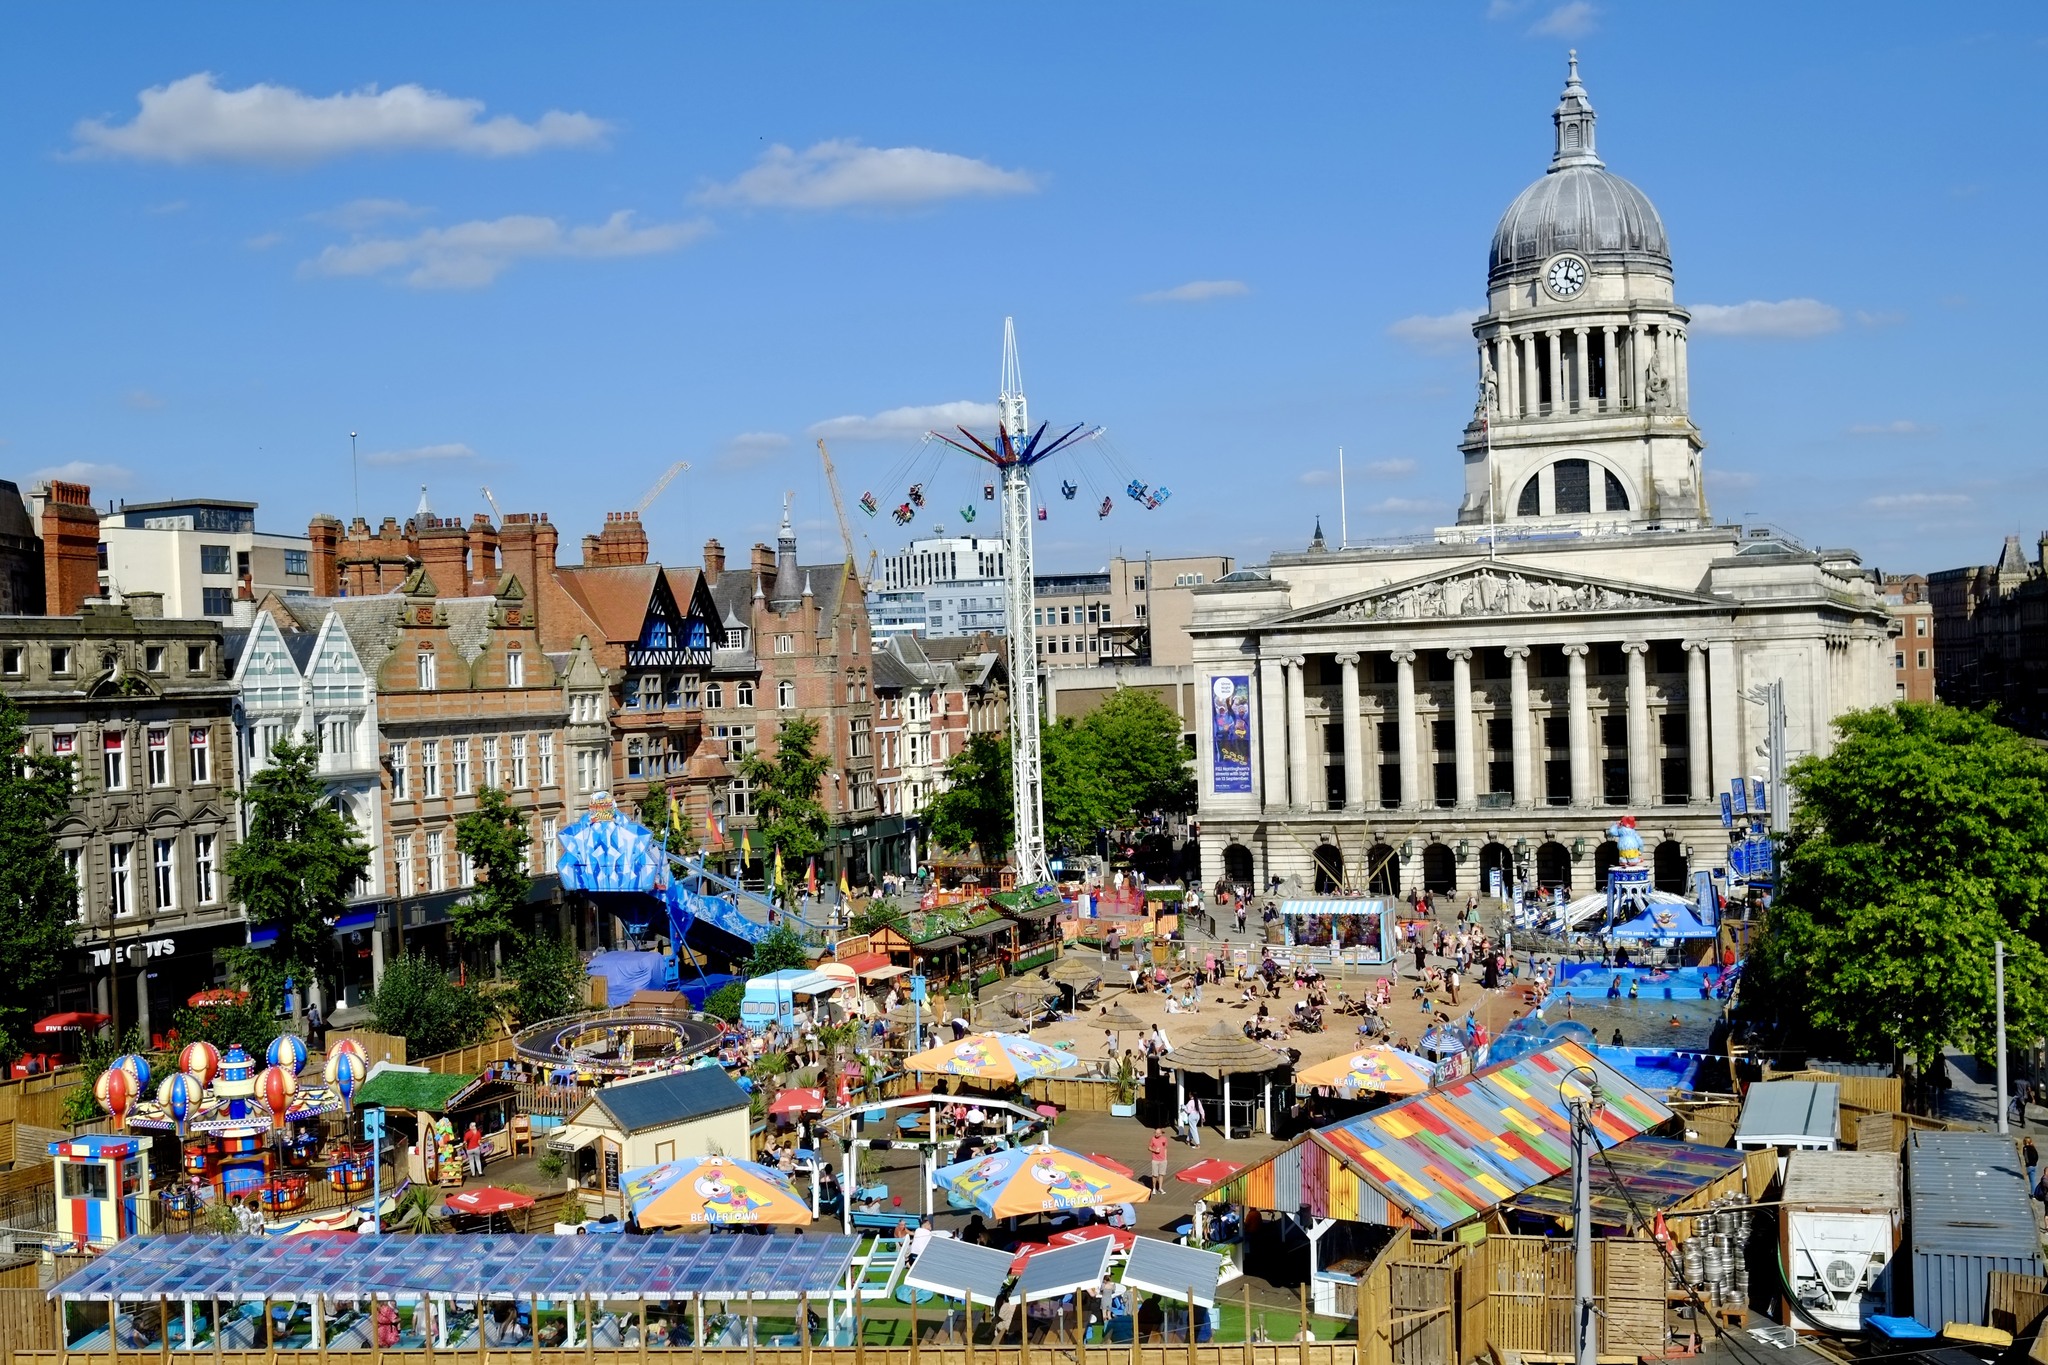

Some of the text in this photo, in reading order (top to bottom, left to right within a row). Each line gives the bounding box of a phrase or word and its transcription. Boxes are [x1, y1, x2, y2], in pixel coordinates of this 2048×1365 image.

[1492, 870, 1500, 887] YETI
[88, 946, 124, 967] IVE
[936, 1064, 980, 1075] BEAVERTOWN
[1334, 1077, 1386, 1090] BEAVERTOWN
[1042, 1194, 1103, 1209] BEAVERTOWN
[690, 1212, 758, 1222] BEAVERTOWN
